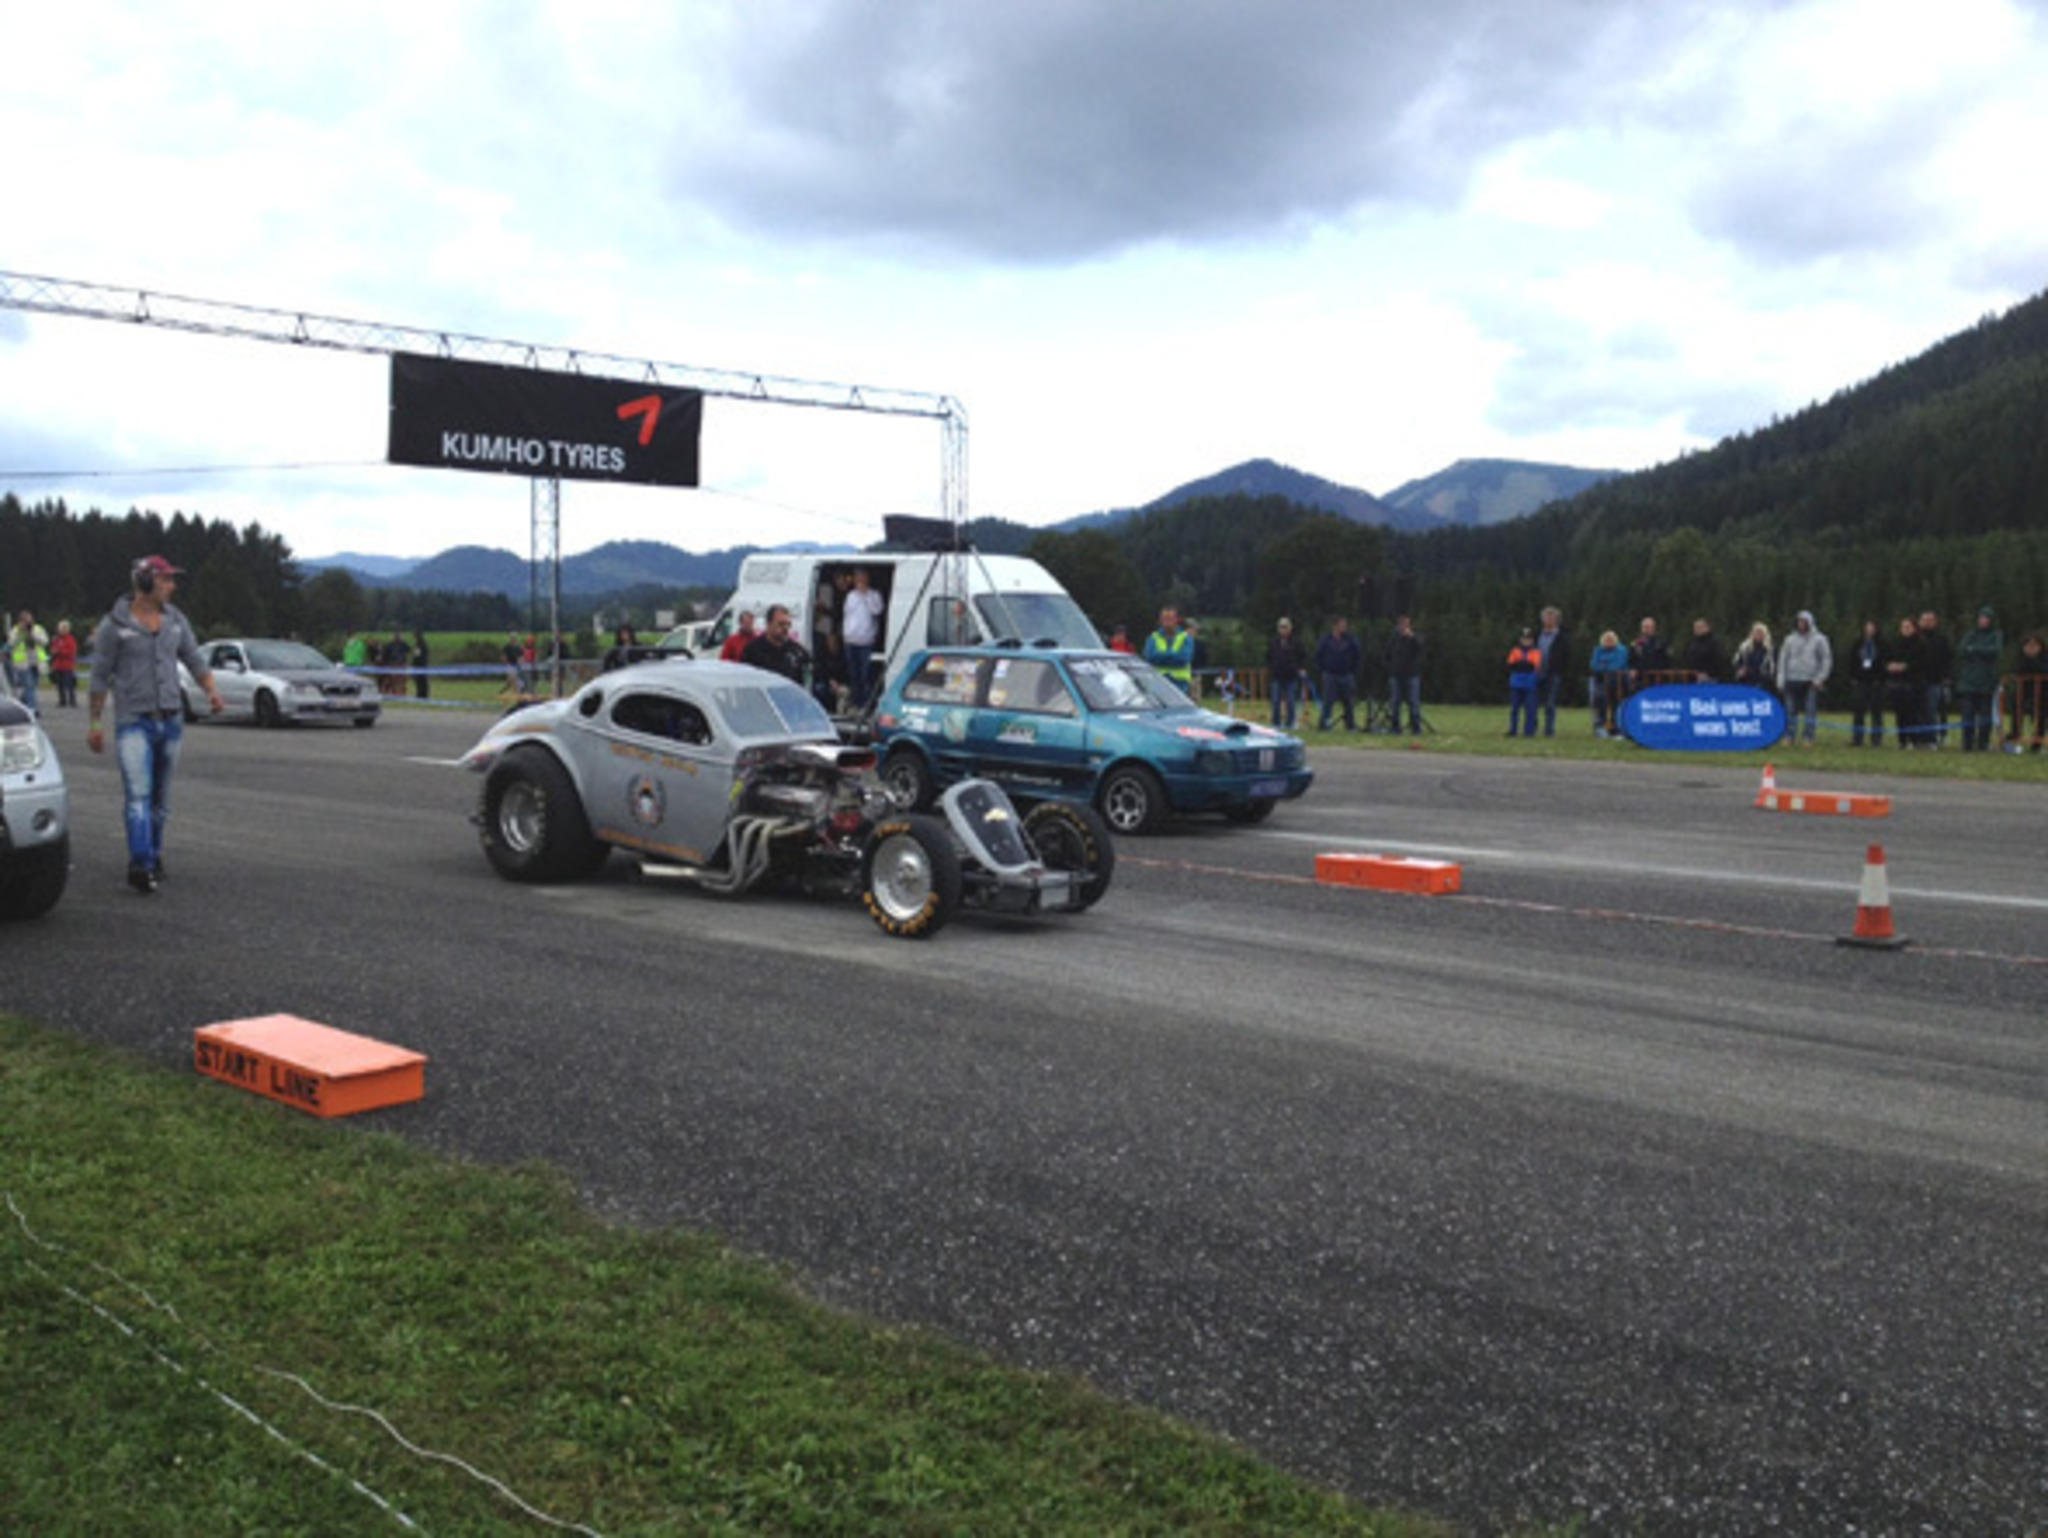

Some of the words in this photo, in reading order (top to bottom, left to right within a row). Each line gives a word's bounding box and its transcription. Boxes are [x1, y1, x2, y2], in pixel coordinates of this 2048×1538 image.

[442, 432, 545, 466] KUMHO
[549, 440, 625, 472] TYRES
[197, 1041, 259, 1083] START
[271, 1065, 321, 1107] LINE
